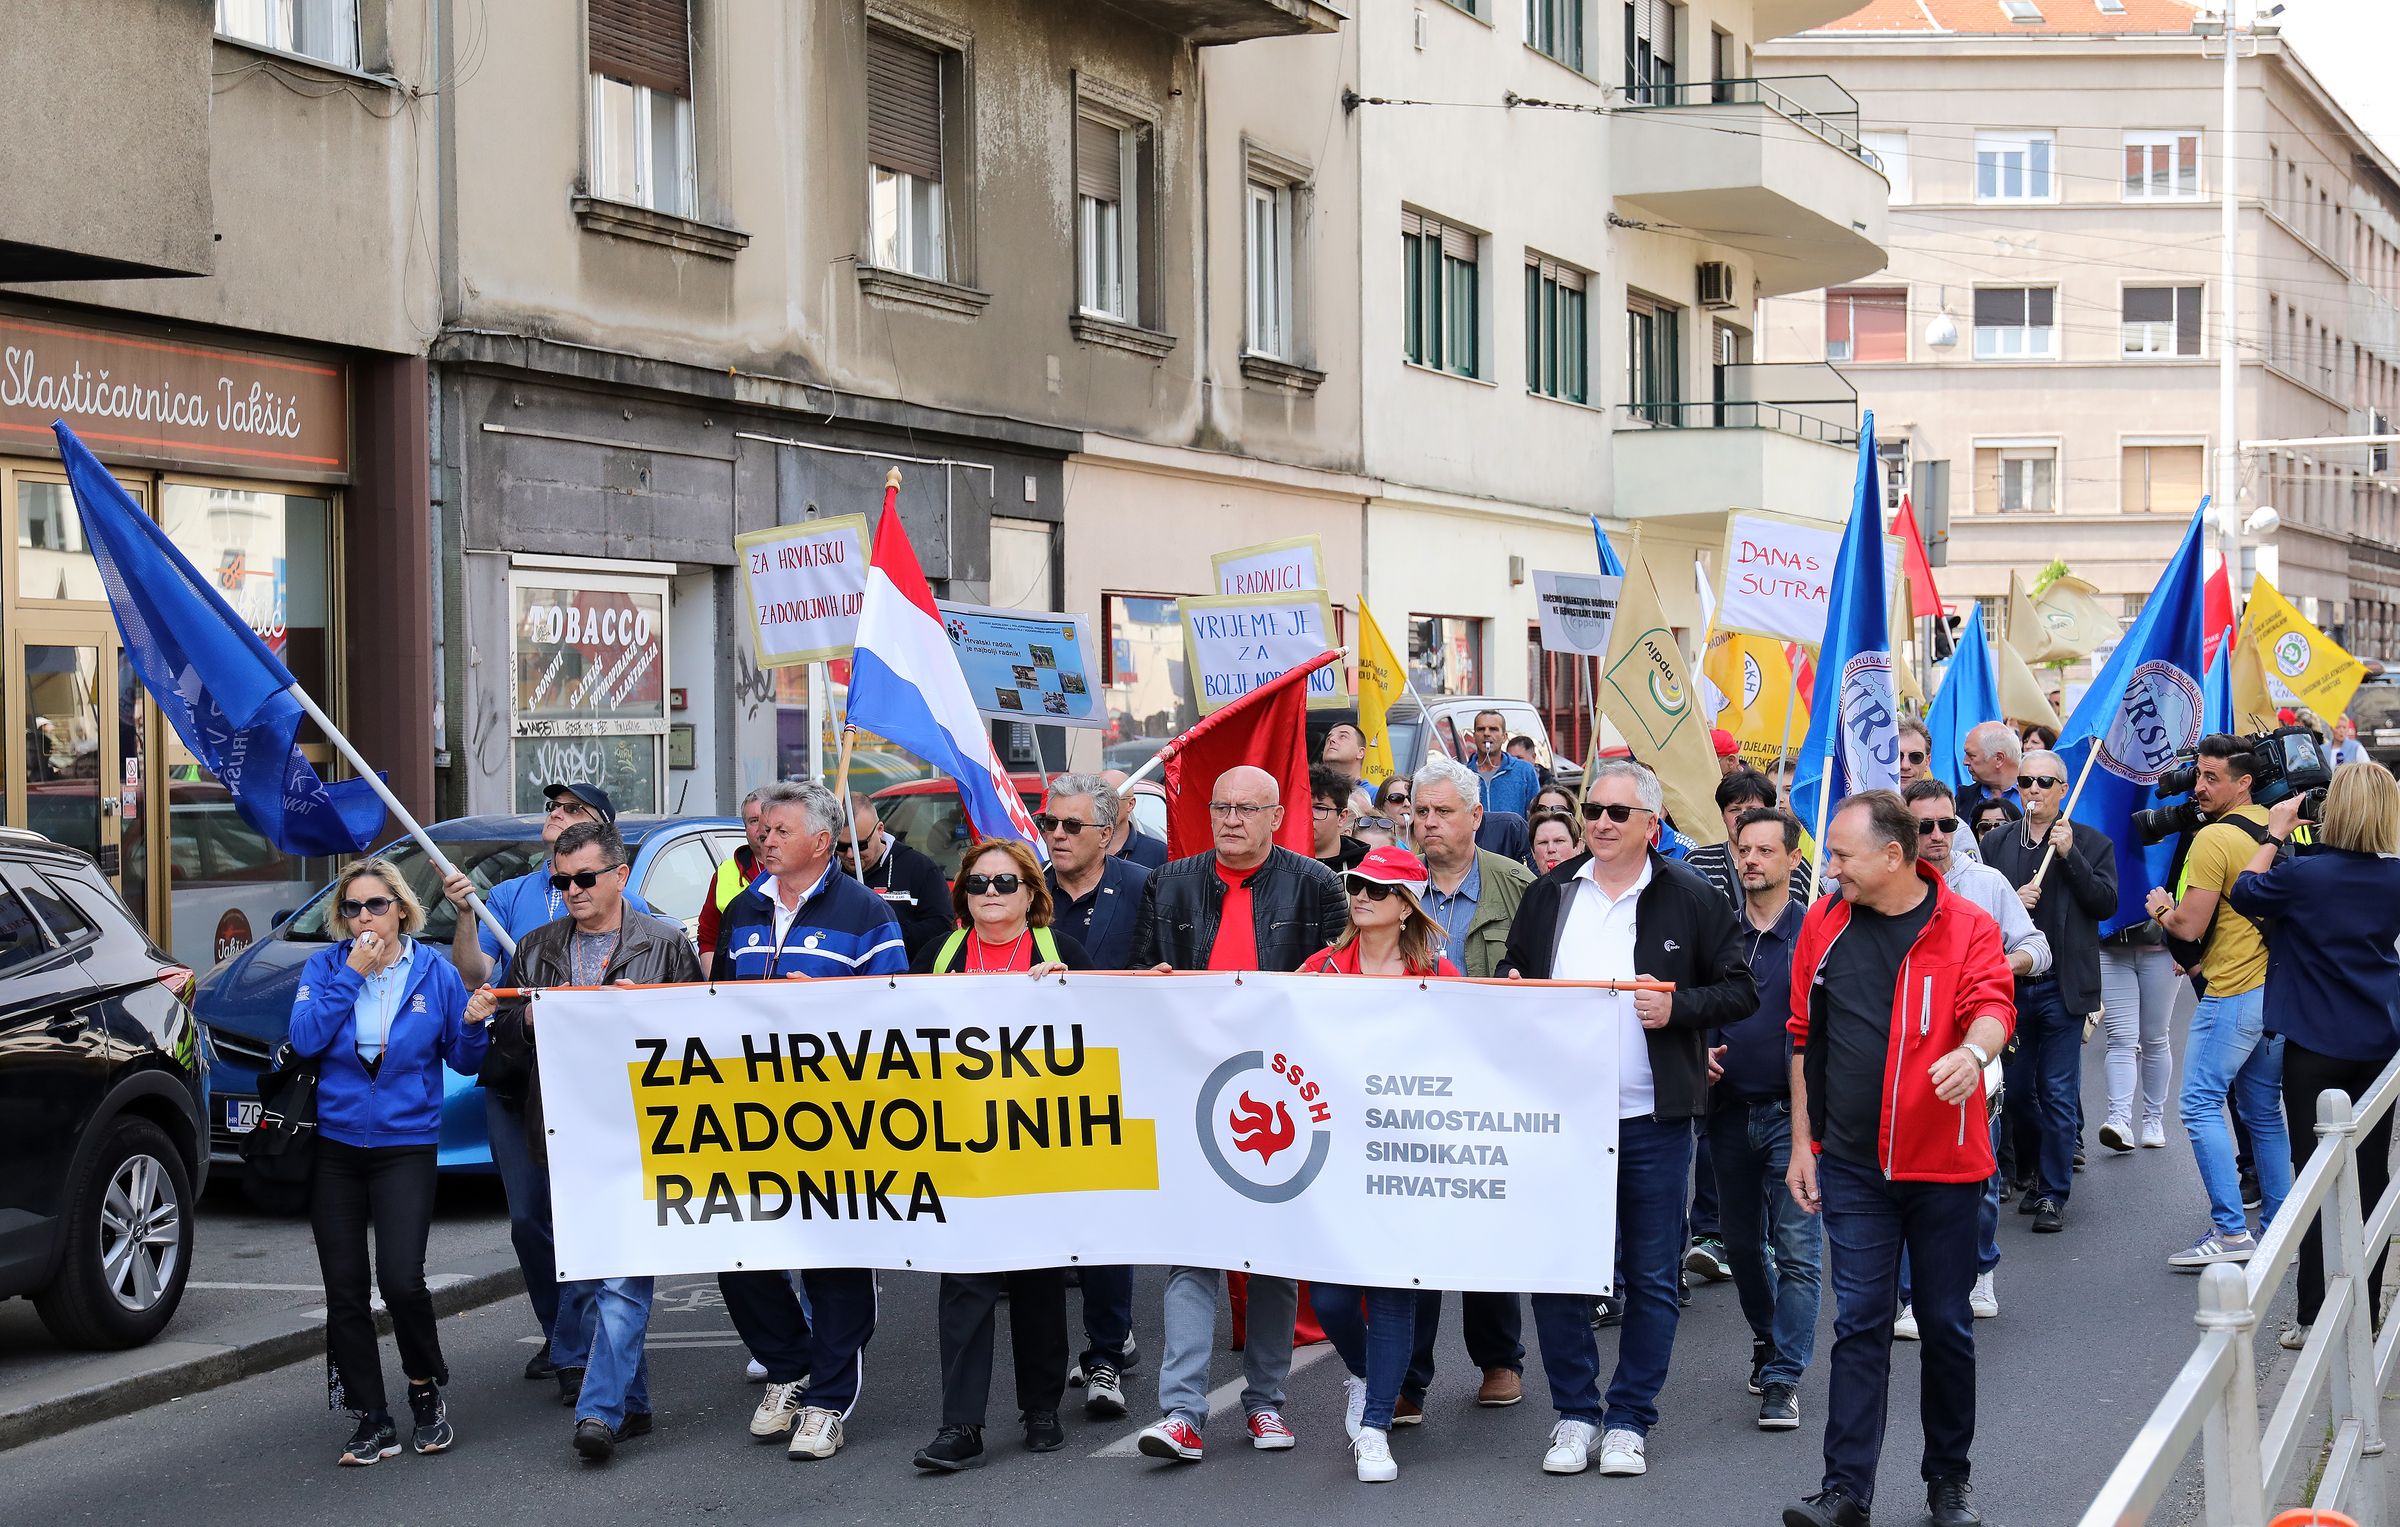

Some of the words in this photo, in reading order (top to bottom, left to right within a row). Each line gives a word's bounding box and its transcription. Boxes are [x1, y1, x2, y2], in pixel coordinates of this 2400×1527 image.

[1, 346, 209, 428] Slastičarnica
[216, 377, 300, 438] Jakšić
[752, 553, 769, 575] ZA
[778, 541, 845, 570] HRVATSKU
[1737, 540, 1820, 571] DANAS
[1236, 564, 1301, 594] RADNICI
[1738, 573, 1828, 603] SUTRA
[759, 595, 839, 625] ZADOVOLJNIH
[1193, 612, 1280, 639] VRIJEME
[1288, 610, 1316, 636] JE
[530, 605, 650, 646] TOBACCO
[964, 637, 991, 647] Hrvatski
[992, 640, 1013, 649] radnik
[1238, 645, 1269, 660] ZA
[2288, 634, 2308, 652] SSKH
[589, 641, 638, 710] FOTOKOPIRANJE
[1645, 640, 1674, 681] ppdiv
[1844, 656, 1882, 674] UDRUGA
[2135, 662, 2166, 676] UDRUGA
[610, 642, 659, 712] GALANTERIJA
[1204, 673, 1249, 697] BOLJE
[2122, 679, 2176, 770] URSH
[634, 1036, 725, 1087] ZA
[741, 1023, 1086, 1083] HRVATSKU
[1271, 1052, 1332, 1124] SSSH
[1365, 1074, 1453, 1097] SAVEZ
[646, 1094, 1123, 1155] ZADOVOLJNIH
[1365, 1108, 1560, 1134] SAMOSTALNIH
[1366, 1141, 1508, 1166] SINDIKATA
[657, 1169, 947, 1226] RADNIKA
[1366, 1174, 1506, 1200] HRVATSKE
